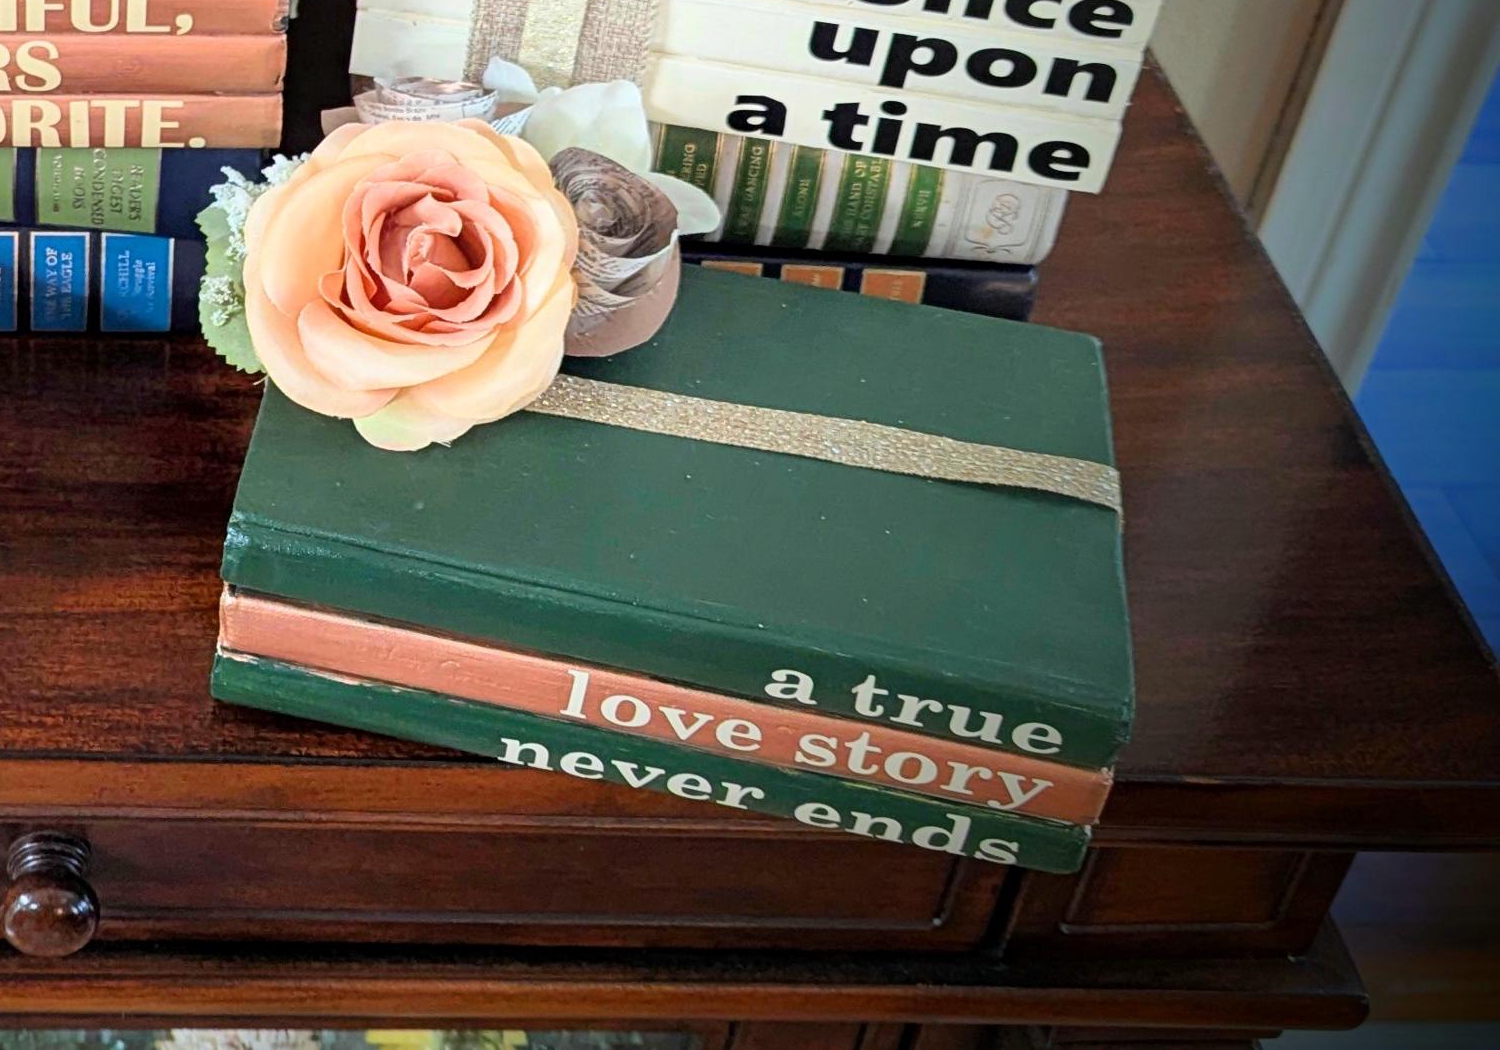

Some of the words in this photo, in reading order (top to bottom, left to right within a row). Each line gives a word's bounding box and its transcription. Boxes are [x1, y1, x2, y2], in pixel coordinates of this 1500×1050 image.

[808, 20, 1118, 104] upon
[726, 94, 788, 138] a
[822, 100, 1091, 182] time
[742, 145, 763, 201] DANCING
[845, 182, 863, 216] HAND
[45, 246, 58, 267] OF
[60, 252, 72, 293] EAGLE
[559, 669, 763, 752] love
[794, 731, 1054, 811] story
[764, 667, 817, 706] a
[851, 673, 1065, 754] true
[496, 736, 766, 810] never
[793, 801, 1022, 867] ends
